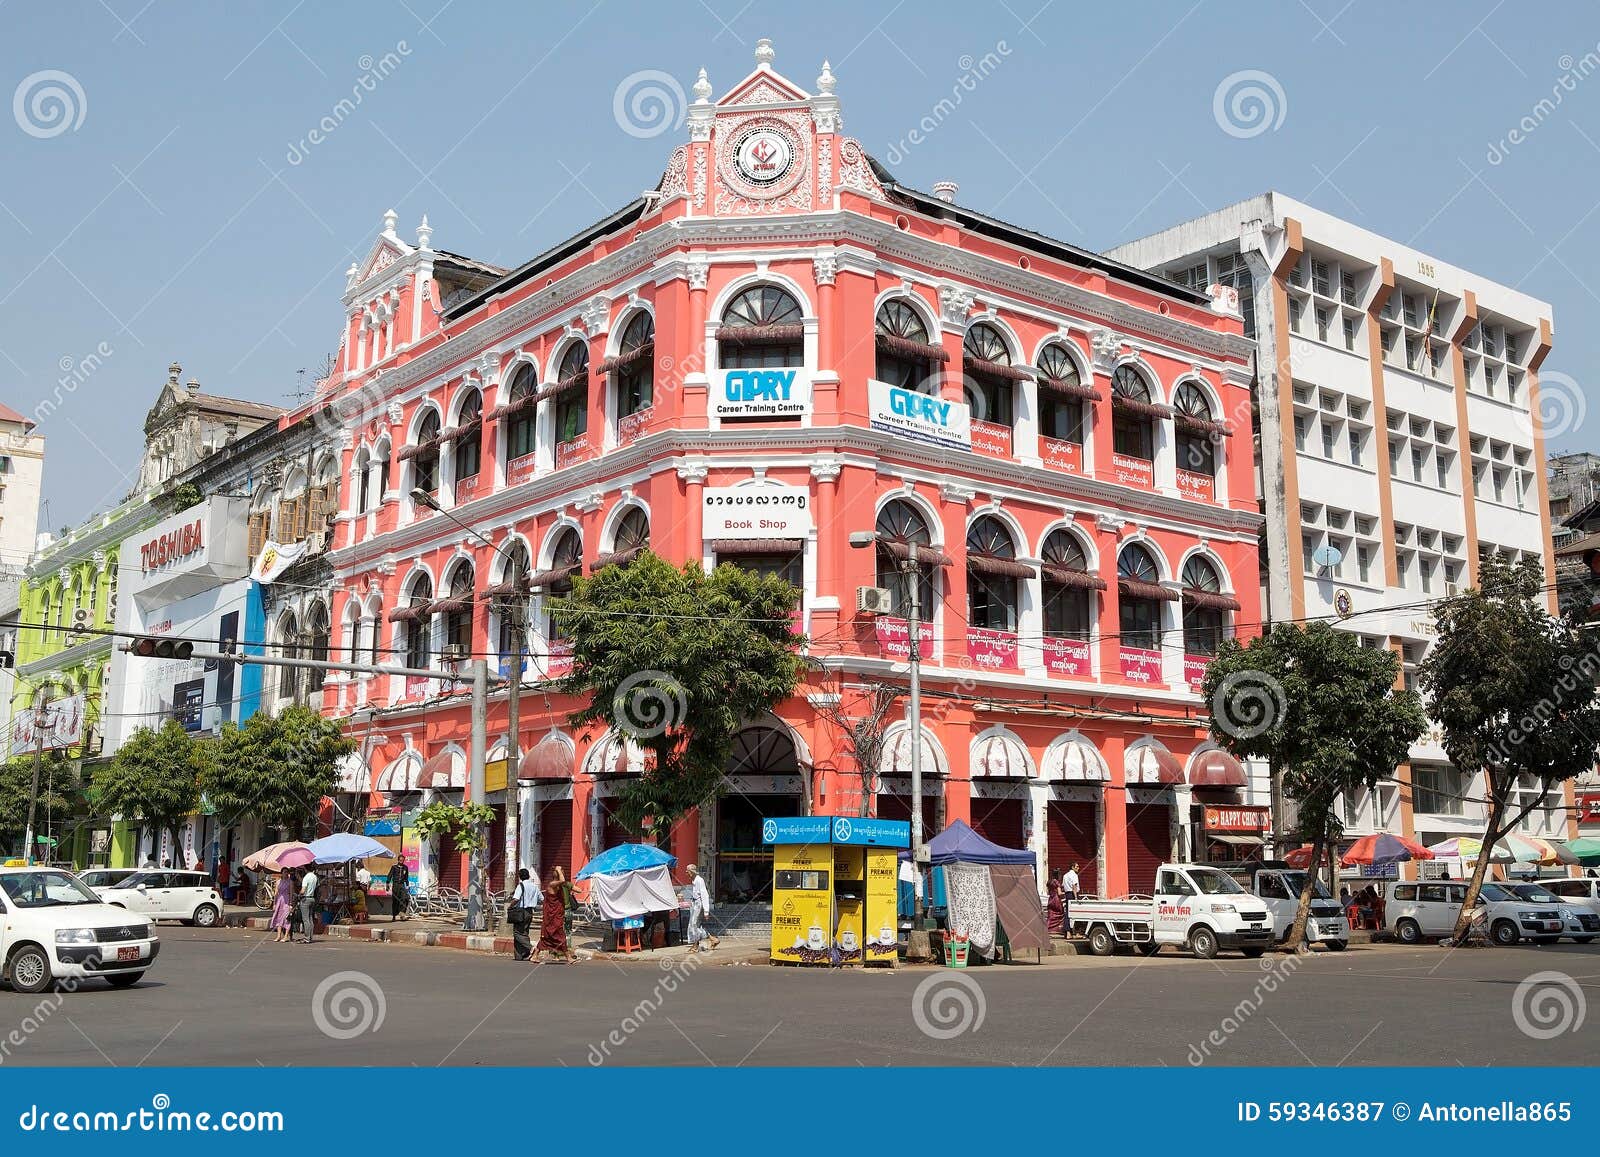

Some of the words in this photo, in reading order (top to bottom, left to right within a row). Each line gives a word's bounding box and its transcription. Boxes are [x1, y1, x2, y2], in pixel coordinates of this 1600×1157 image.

[717, 405, 743, 413] Career
[745, 404, 776, 414] Training
[778, 403, 805, 412] Centre
[878, 412, 904, 425] Career
[905, 419, 936, 434] Training
[937, 427, 962, 440] Centre
[1112, 455, 1151, 473] Handphone
[724, 519, 753, 529] Book
[759, 519, 787, 530] Shop
[141, 518, 202, 573] TOSHIBA
[1220, 811, 1241, 826] HAPPY
[1158, 905, 1176, 915] ZAW
[1176, 905, 1191, 916] YAR
[775, 916, 801, 925] PREMIER
